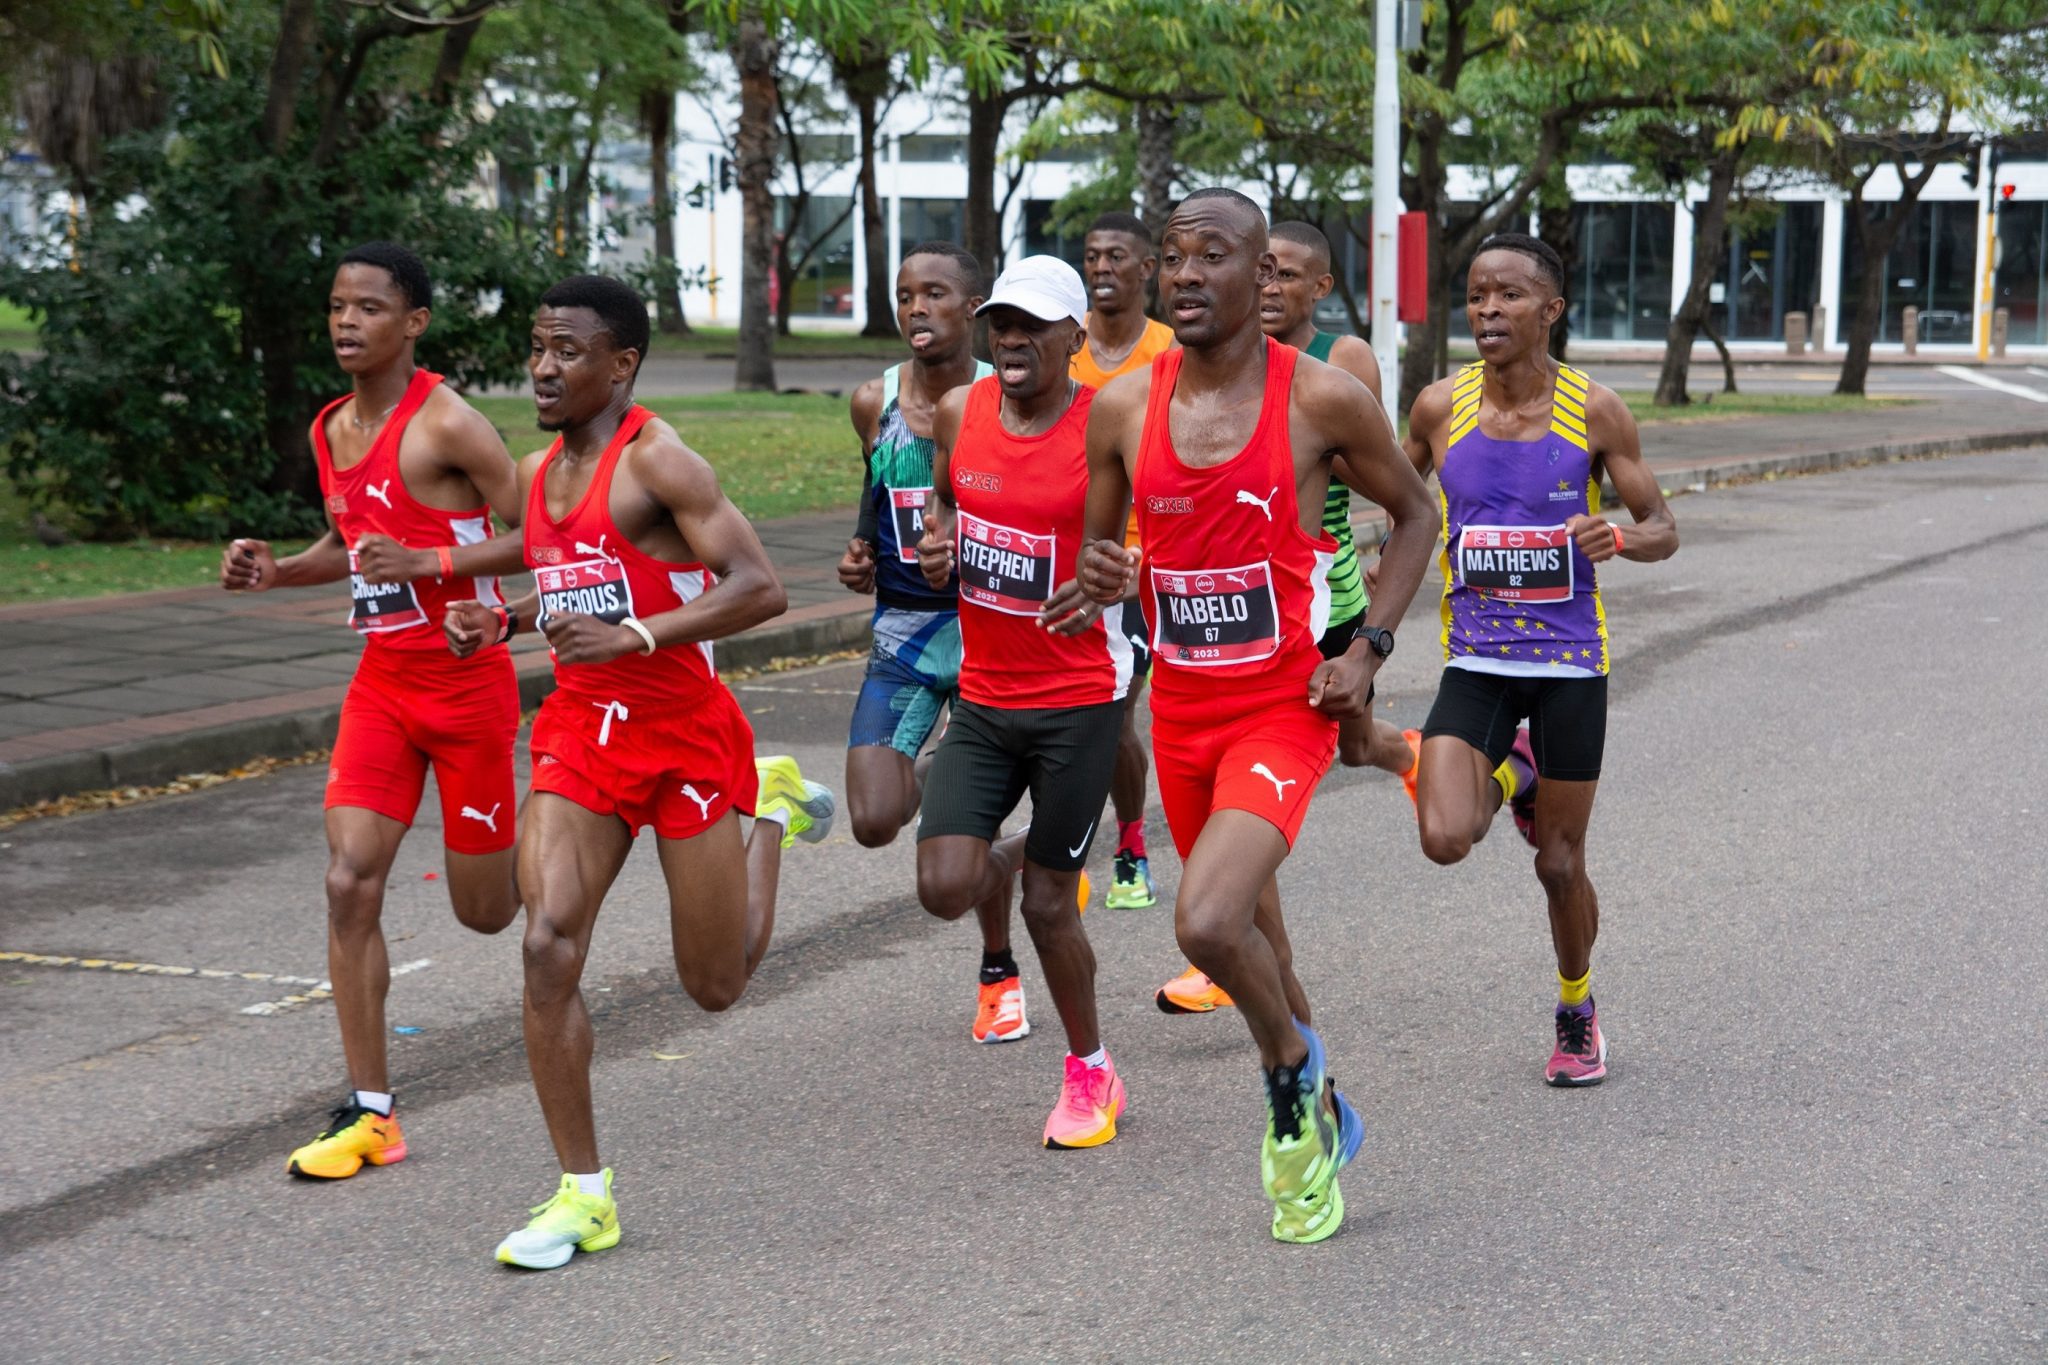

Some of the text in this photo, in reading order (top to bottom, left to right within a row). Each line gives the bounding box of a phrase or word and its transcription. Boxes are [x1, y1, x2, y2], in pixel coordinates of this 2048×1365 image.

[1146, 495, 1194, 514] BOXER
[963, 538, 1035, 582] STEPHEN
[1466, 548, 1560, 572] MATHEWS
[988, 576, 1000, 591] 61
[1509, 574, 1522, 586] 82
[975, 590, 998, 603] 2023
[1498, 590, 1521, 598] 2023
[1169, 594, 1249, 625] KABELO
[1205, 627, 1219, 643] 67
[1193, 648, 1220, 658] 2023
